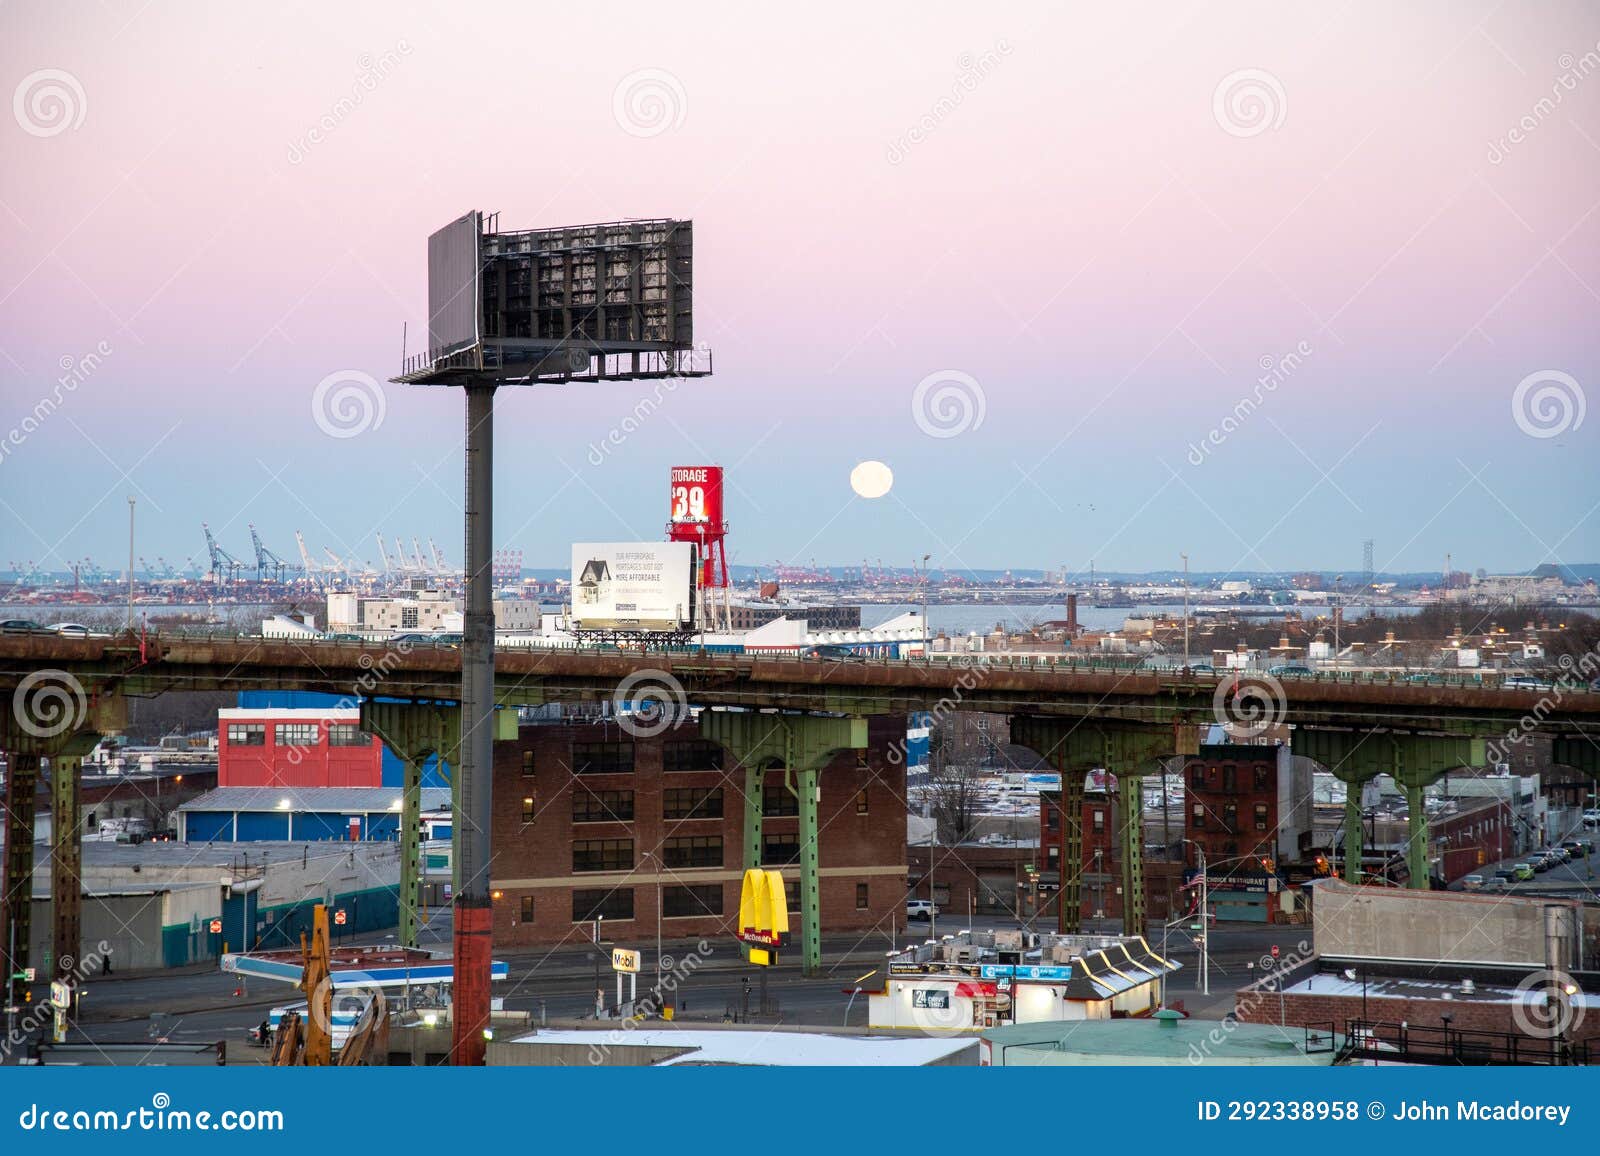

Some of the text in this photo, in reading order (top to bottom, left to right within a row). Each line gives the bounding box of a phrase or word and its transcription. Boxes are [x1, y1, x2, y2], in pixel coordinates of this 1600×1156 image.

[672, 469, 708, 482] STORAGE
[614, 953, 634, 968] Mobil
[915, 990, 927, 1003] 24
